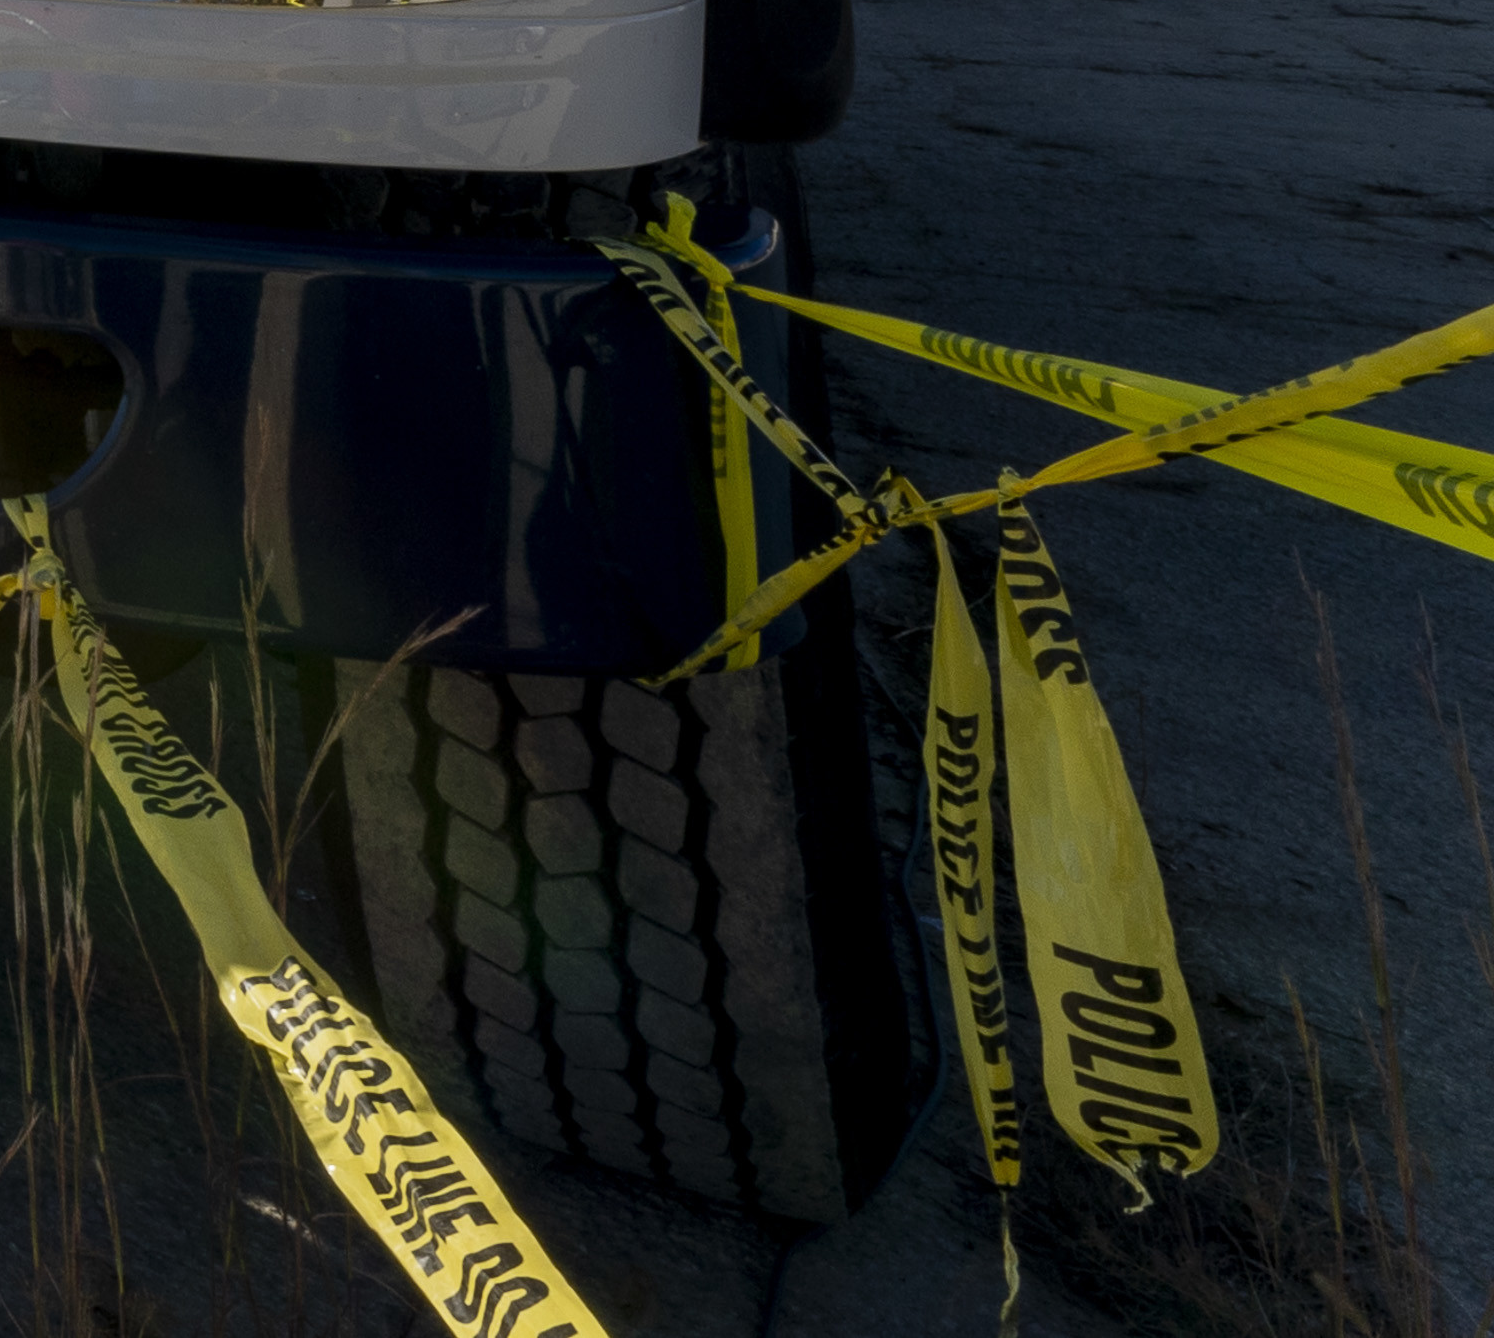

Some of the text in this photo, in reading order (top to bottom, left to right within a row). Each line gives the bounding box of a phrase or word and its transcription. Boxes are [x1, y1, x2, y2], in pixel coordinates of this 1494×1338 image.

[934, 704, 985, 917] POLICE
[238, 955, 416, 1155] POLICE
[365, 1130, 497, 1278] LINE
[1051, 941, 1202, 1171] POLICE
